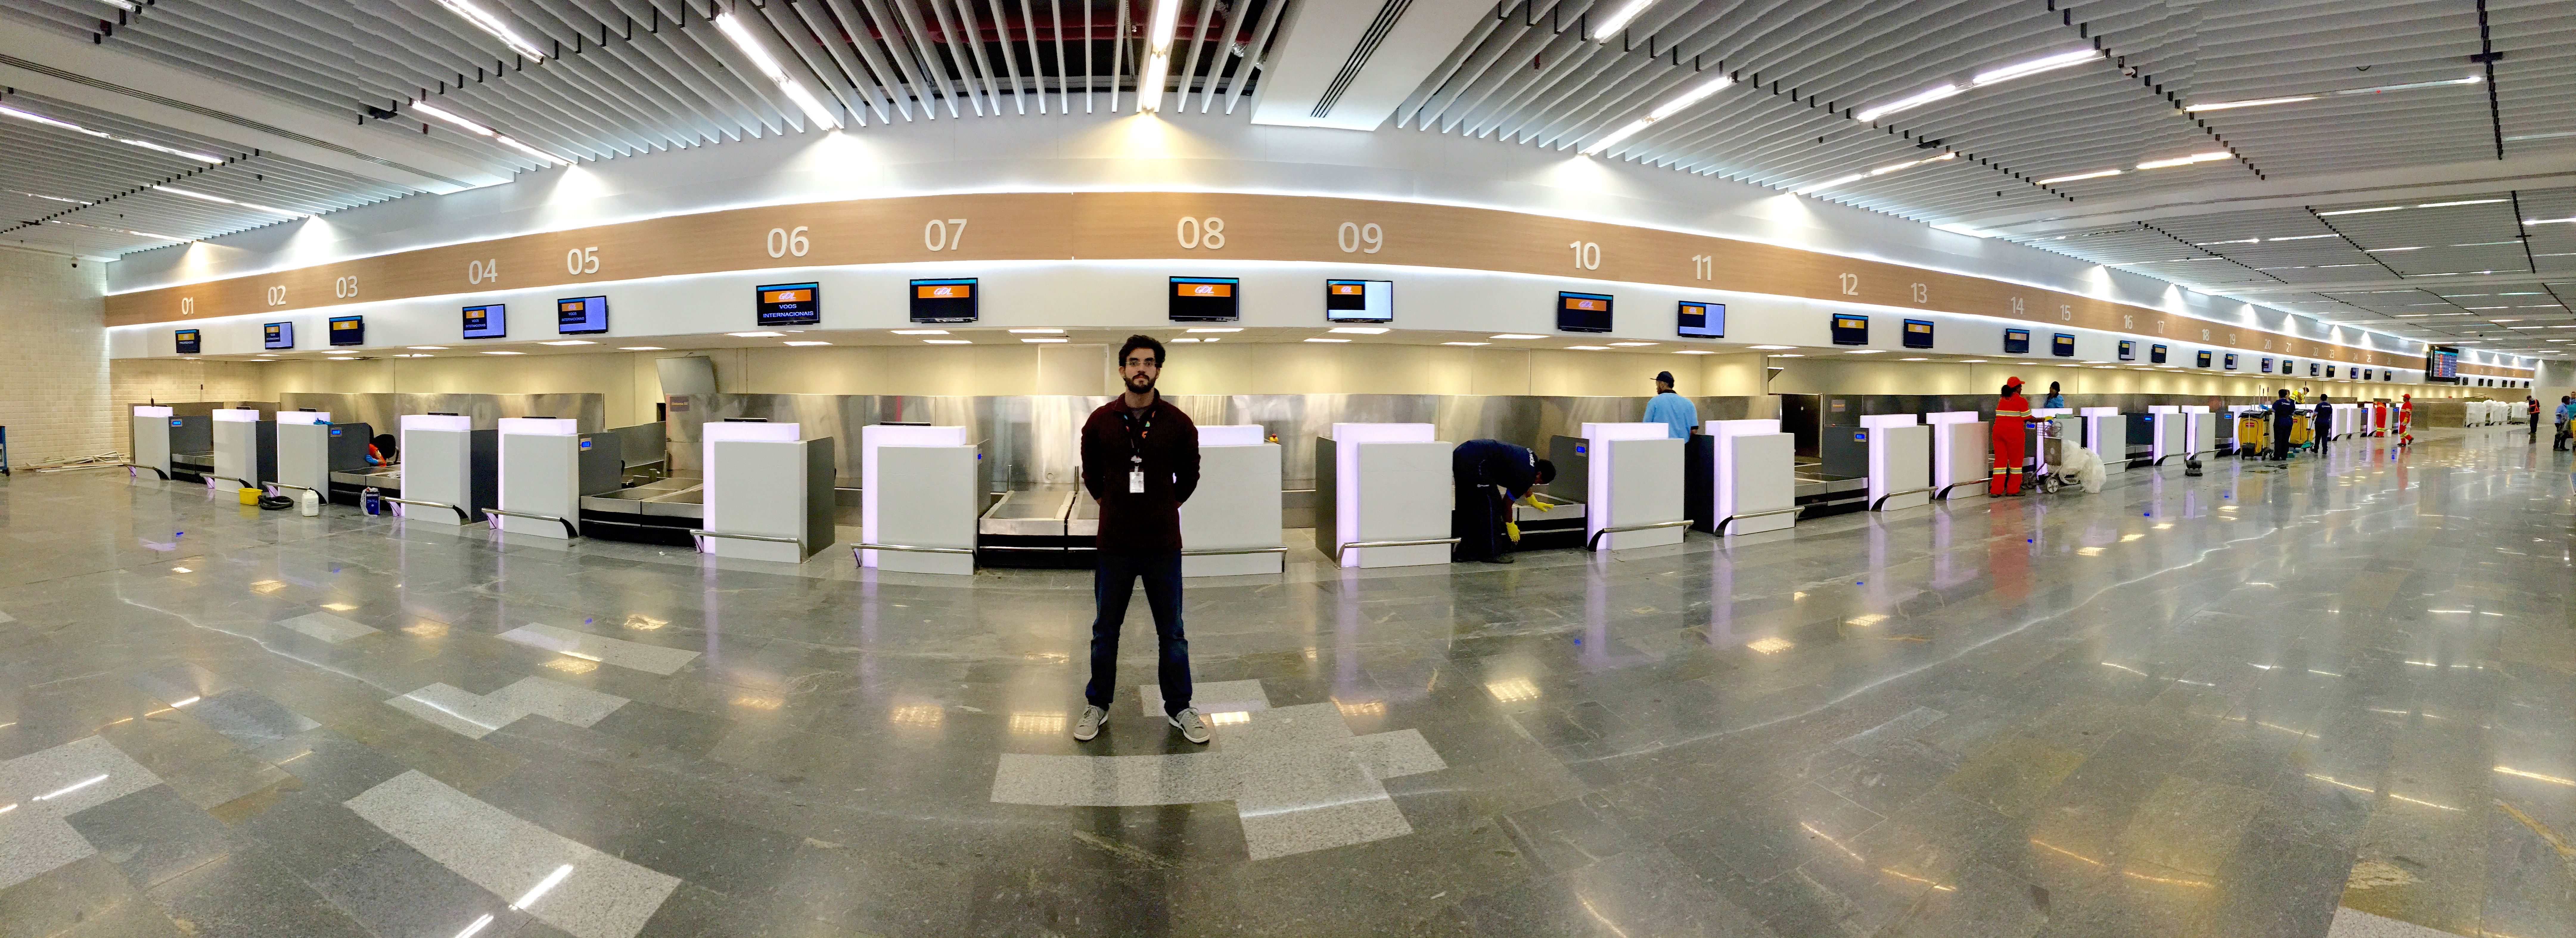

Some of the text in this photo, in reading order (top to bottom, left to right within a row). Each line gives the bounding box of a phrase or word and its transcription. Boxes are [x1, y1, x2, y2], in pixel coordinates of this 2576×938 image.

[925, 219, 967, 251] 07
[1177, 217, 1225, 249] 08
[1339, 222, 1382, 253] 09
[767, 226, 809, 258] 06
[567, 247, 599, 274] 05
[1570, 241, 1600, 270] 10
[469, 259, 498, 284] 04
[1692, 255, 1711, 280] 11
[336, 276, 358, 298] 03
[933, 287, 953, 295] GOL
[1195, 285, 1214, 293] GOL
[1839, 273, 1858, 295] 12
[1910, 282, 1927, 303] 13
[268, 285, 286, 306] 02
[779, 292, 796, 300] GOL
[182, 297, 193, 314] 01
[2011, 297, 2024, 314] 14
[2060, 305, 2070, 321] 15
[2124, 315, 2132, 329] 16
[2157, 321, 2164, 333] 17
[2202, 329, 2209, 341] 18
[2229, 334, 2235, 344] 19
[2265, 339, 2271, 350] 20
[2286, 343, 2291, 352] 21
[2313, 347, 2318, 356] 22
[2330, 350, 2334, 358] 23
